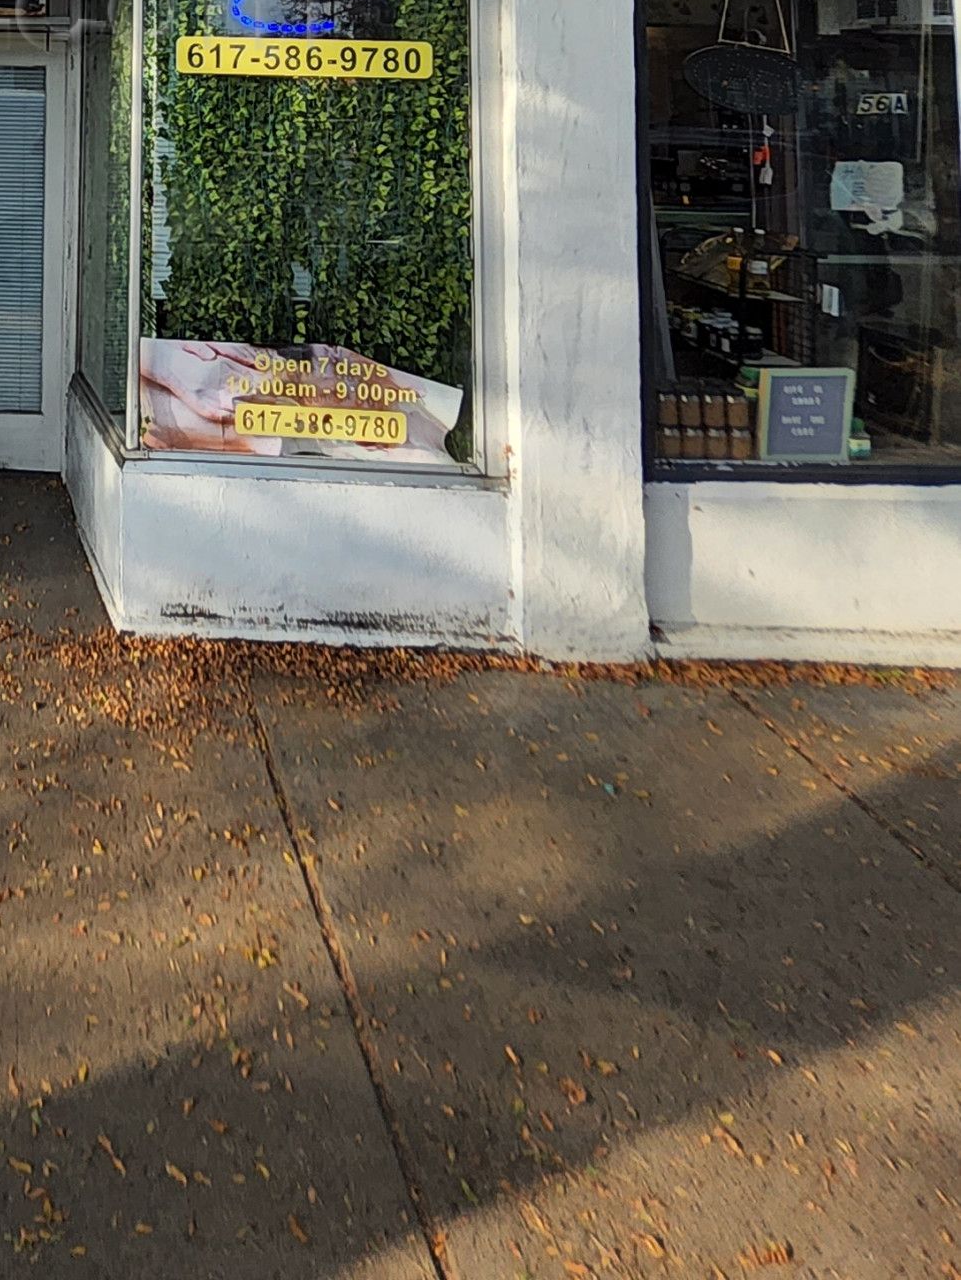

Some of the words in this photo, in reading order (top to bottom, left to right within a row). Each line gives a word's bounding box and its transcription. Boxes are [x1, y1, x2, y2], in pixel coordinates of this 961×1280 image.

[186, 43, 422, 74] 617-586-9780
[860, 94, 906, 113] 56A
[254, 351, 312, 376] Open
[317, 356, 329, 372] 7
[335, 357, 388, 380] days
[241, 407, 400, 440] 617-586-9780
